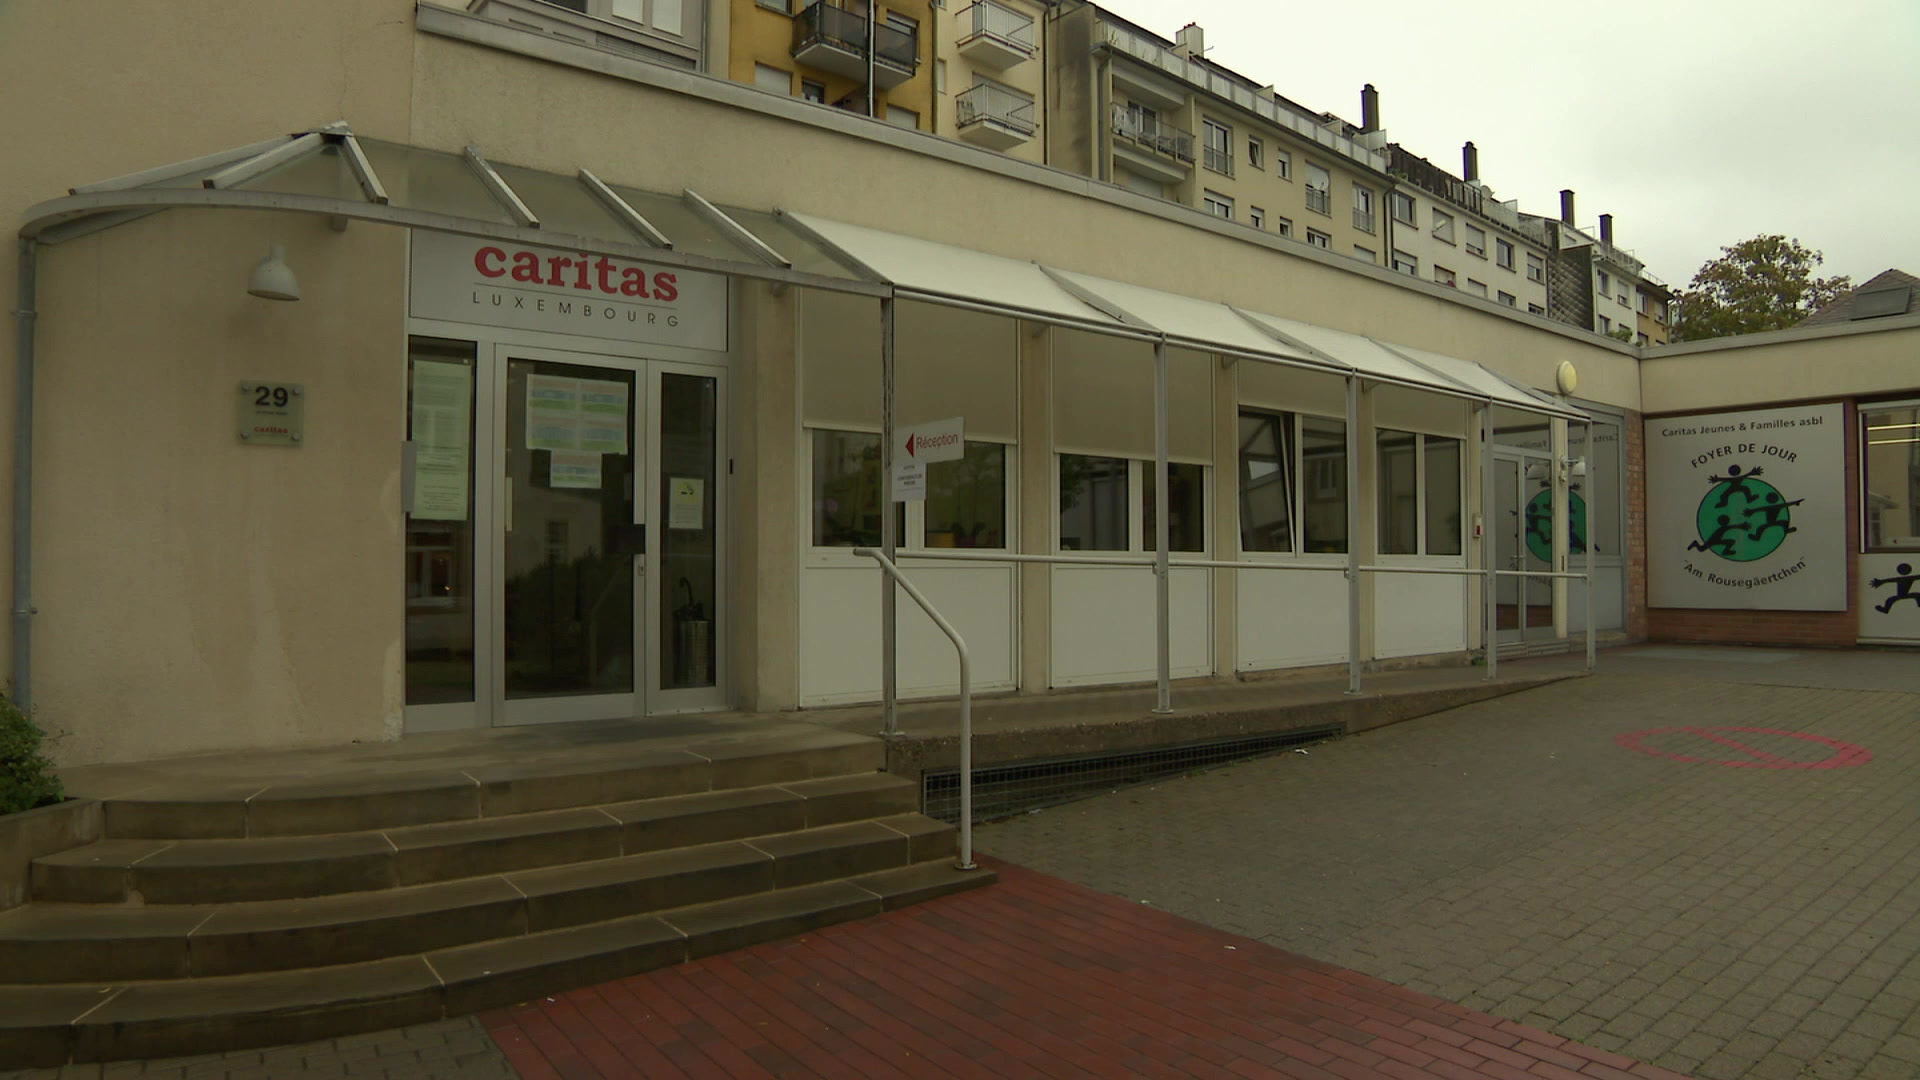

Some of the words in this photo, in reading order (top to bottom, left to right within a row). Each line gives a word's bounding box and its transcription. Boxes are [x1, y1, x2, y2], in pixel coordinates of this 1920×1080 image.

[474, 246, 679, 302] caritas
[472, 291, 679, 327] LUXEMBOURG
[255, 386, 289, 408] 29
[1662, 427, 1697, 437] Caritas
[1700, 424, 1735, 435] Jeunes
[1739, 422, 1747, 432] &
[1750, 419, 1796, 431] Familles
[1799, 416, 1824, 427] asbl
[916, 432, 958, 449] Réception
[1691, 445, 1733, 469] FOYER
[1738, 443, 1757, 454] DE
[1761, 444, 1798, 463] JOUR
